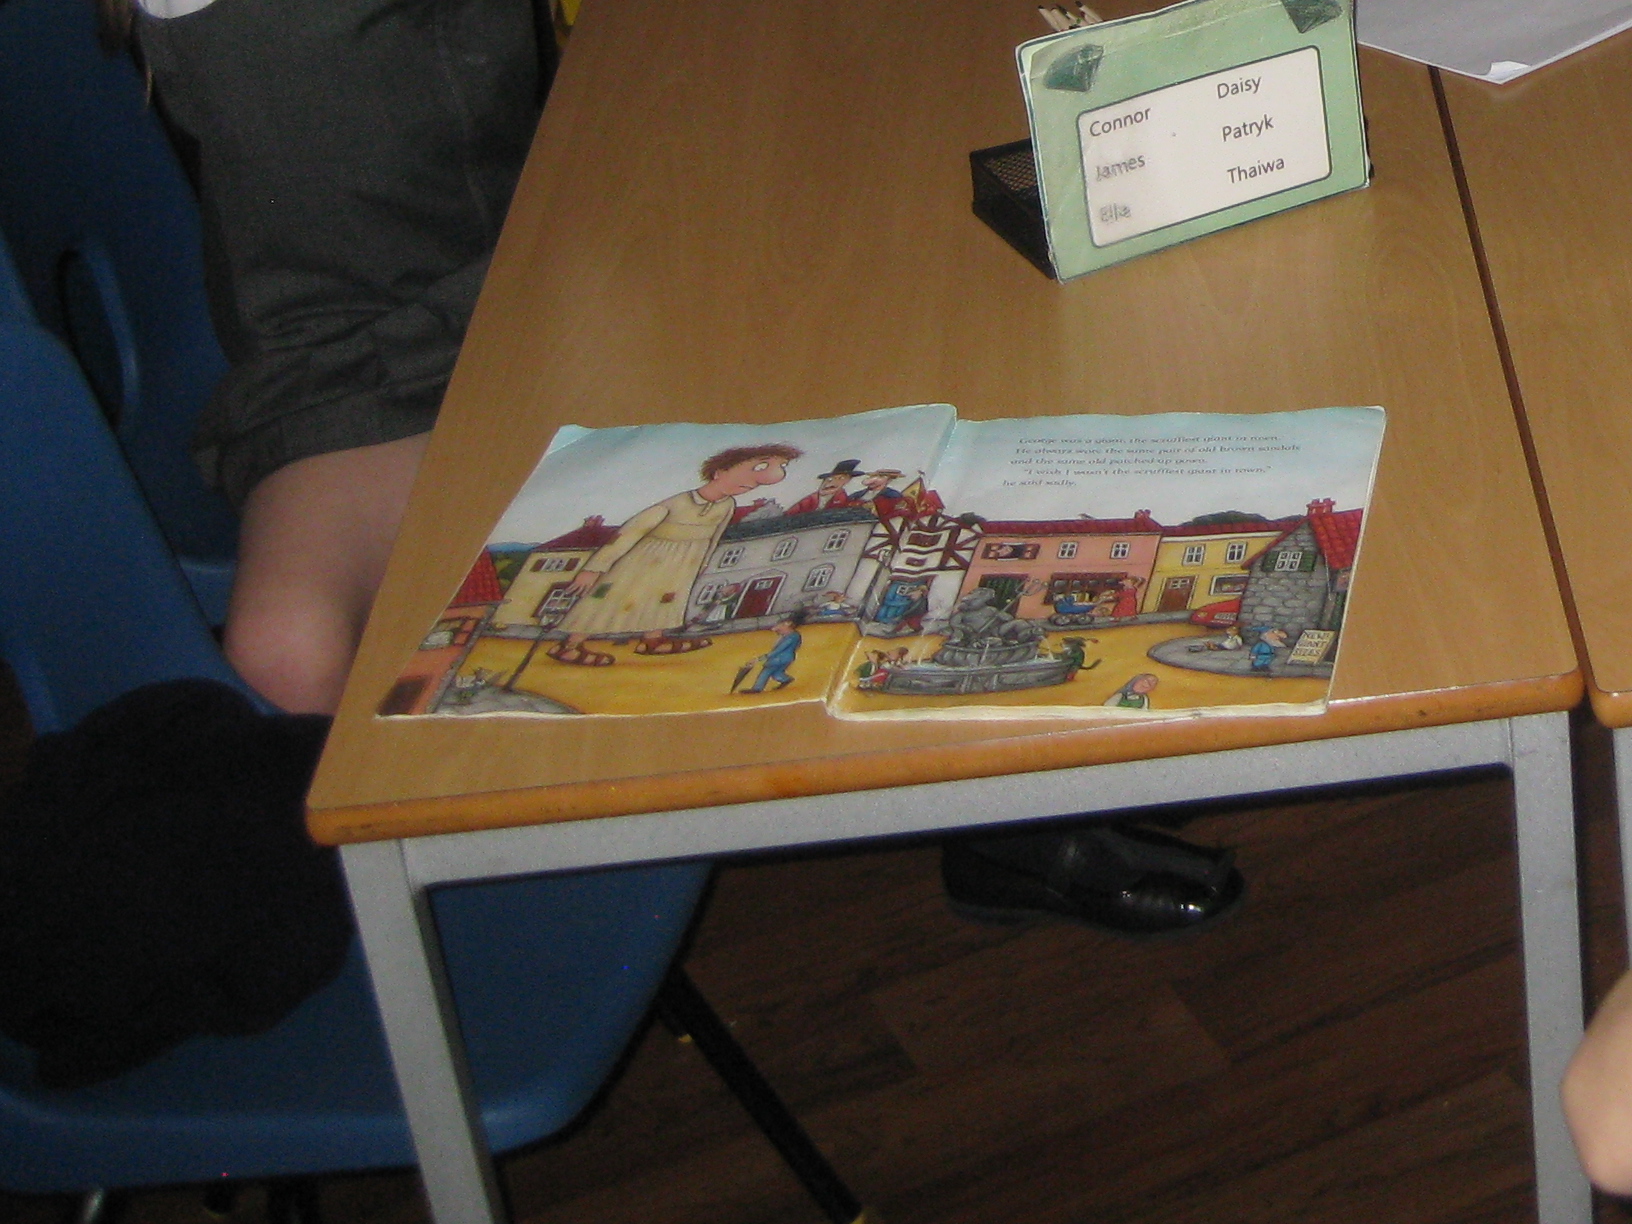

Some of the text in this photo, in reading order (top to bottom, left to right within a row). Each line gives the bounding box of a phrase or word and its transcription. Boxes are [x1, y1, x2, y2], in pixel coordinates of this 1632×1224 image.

[1216, 76, 1263, 100] Daisy
[1089, 107, 1152, 137] Connor
[1221, 113, 1275, 143] Patryk
[1226, 157, 1286, 185] Thaiwa
[1019, 437, 1056, 446] George
[1151, 436, 1201, 445] scruffiest
[1203, 434, 1232, 443] giant
[1034, 447, 1073, 455] always
[1158, 447, 1182, 456] pair
[1010, 457, 1033, 465] and
[1035, 457, 1054, 465] the
[1088, 457, 1107, 465] old
[1036, 467, 1062, 475] wish
[1112, 467, 1130, 475] the
[1134, 467, 1185, 475] scruffiest
[1187, 467, 1217, 475] giant
[1019, 478, 1043, 486] said
